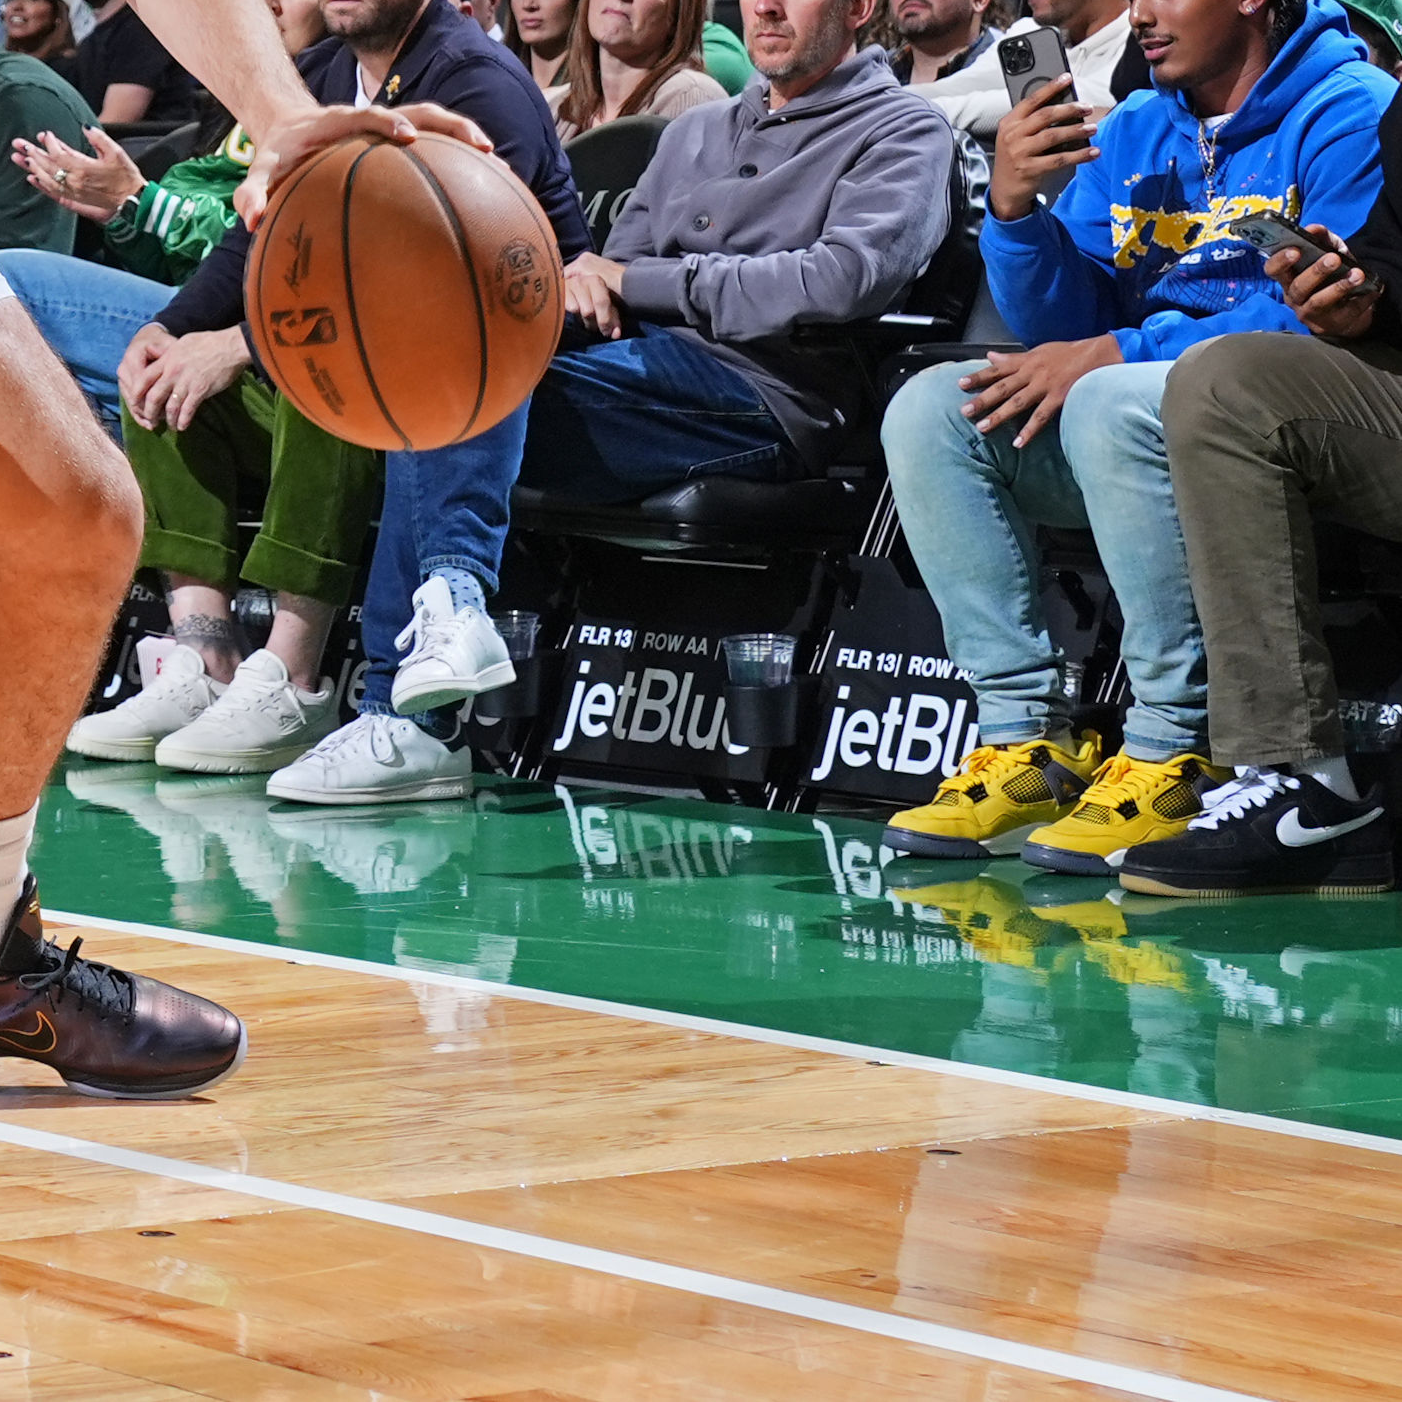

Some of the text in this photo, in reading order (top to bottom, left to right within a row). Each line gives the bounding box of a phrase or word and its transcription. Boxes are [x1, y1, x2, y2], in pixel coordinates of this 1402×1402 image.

[578, 625, 612, 646] FLR
[643, 632, 684, 653] ROW
[684, 636, 709, 656] AA
[836, 647, 873, 671] FLR
[907, 655, 954, 679] ROW
